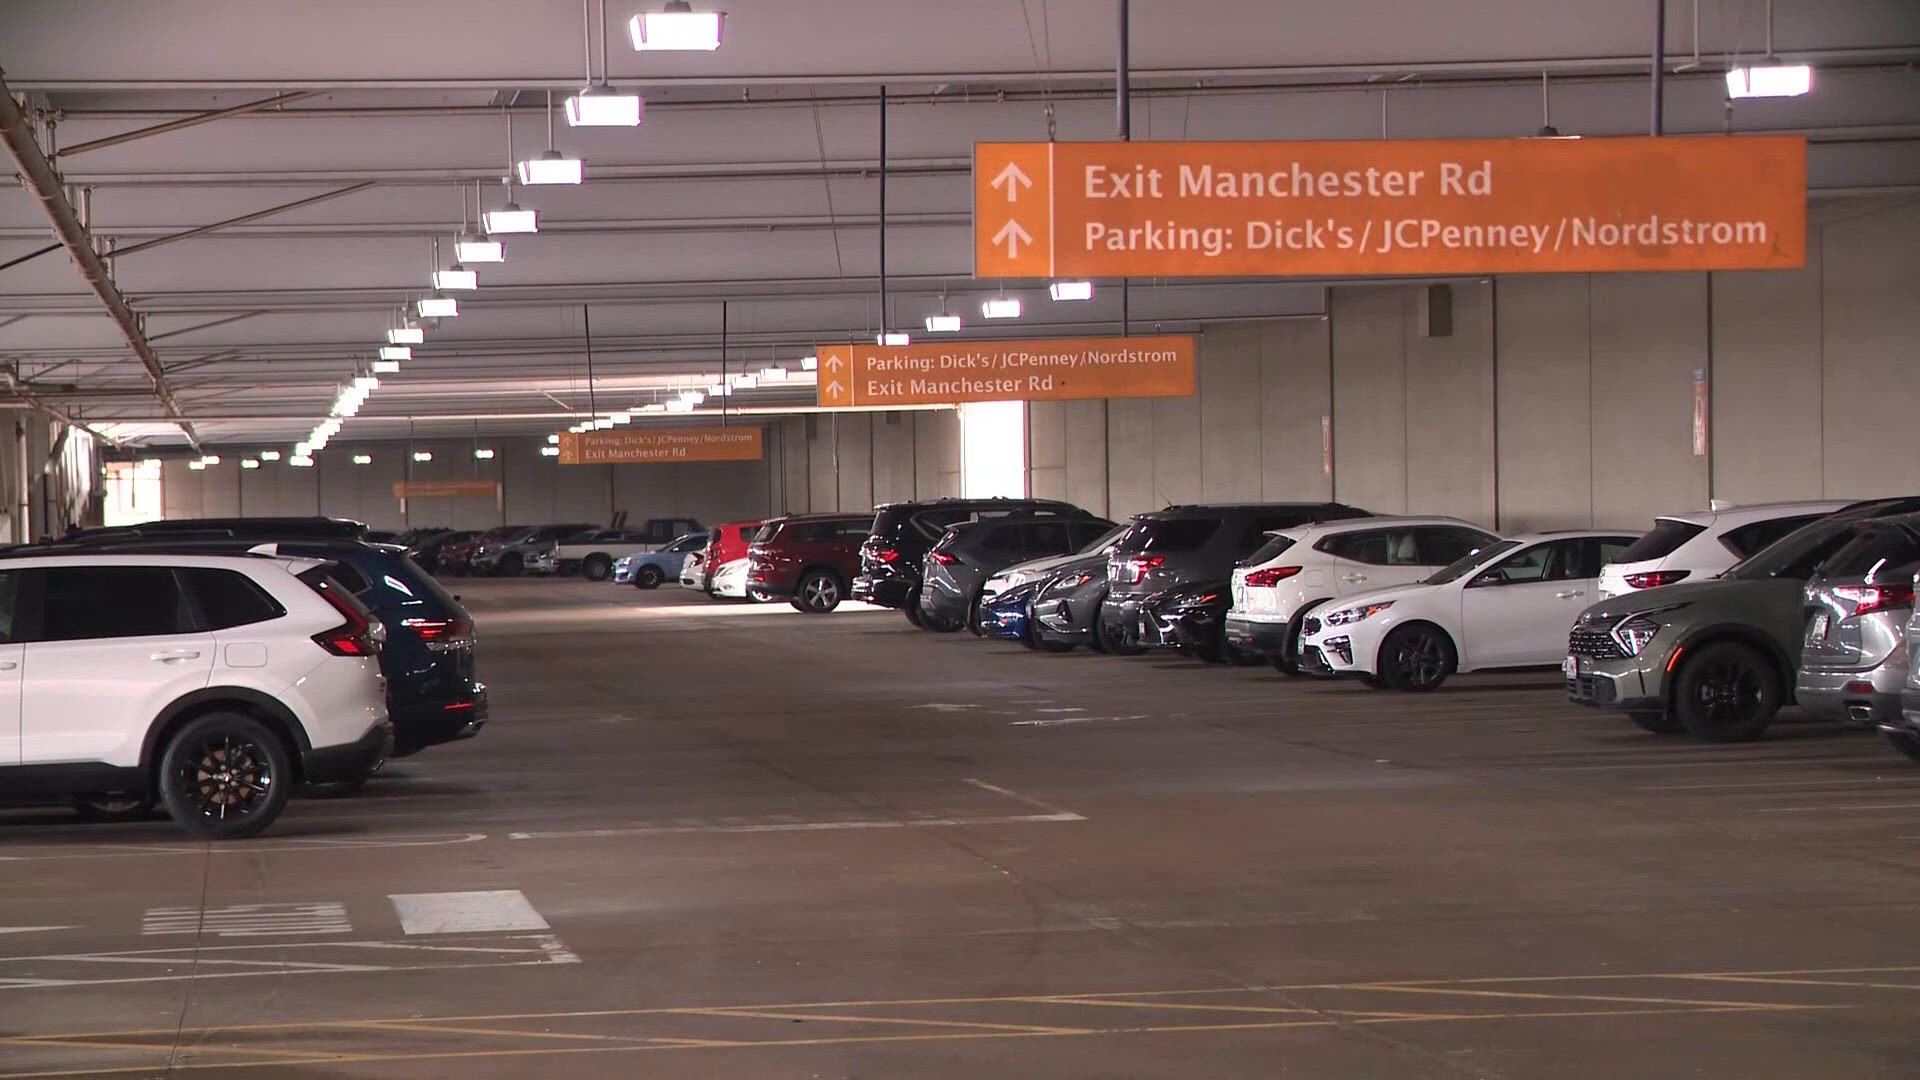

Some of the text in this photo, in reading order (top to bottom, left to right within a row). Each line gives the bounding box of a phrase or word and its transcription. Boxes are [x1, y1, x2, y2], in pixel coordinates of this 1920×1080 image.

[1085, 160, 1492, 199] Exit Manchester Rd
[1085, 220, 1233, 257] Parking:
[866, 355, 935, 374] Parking:
[867, 374, 1053, 396] Exit Manchester Rd
[585, 436, 622, 446] Parking:
[585, 446, 686, 459] Exit Manchester Rd
